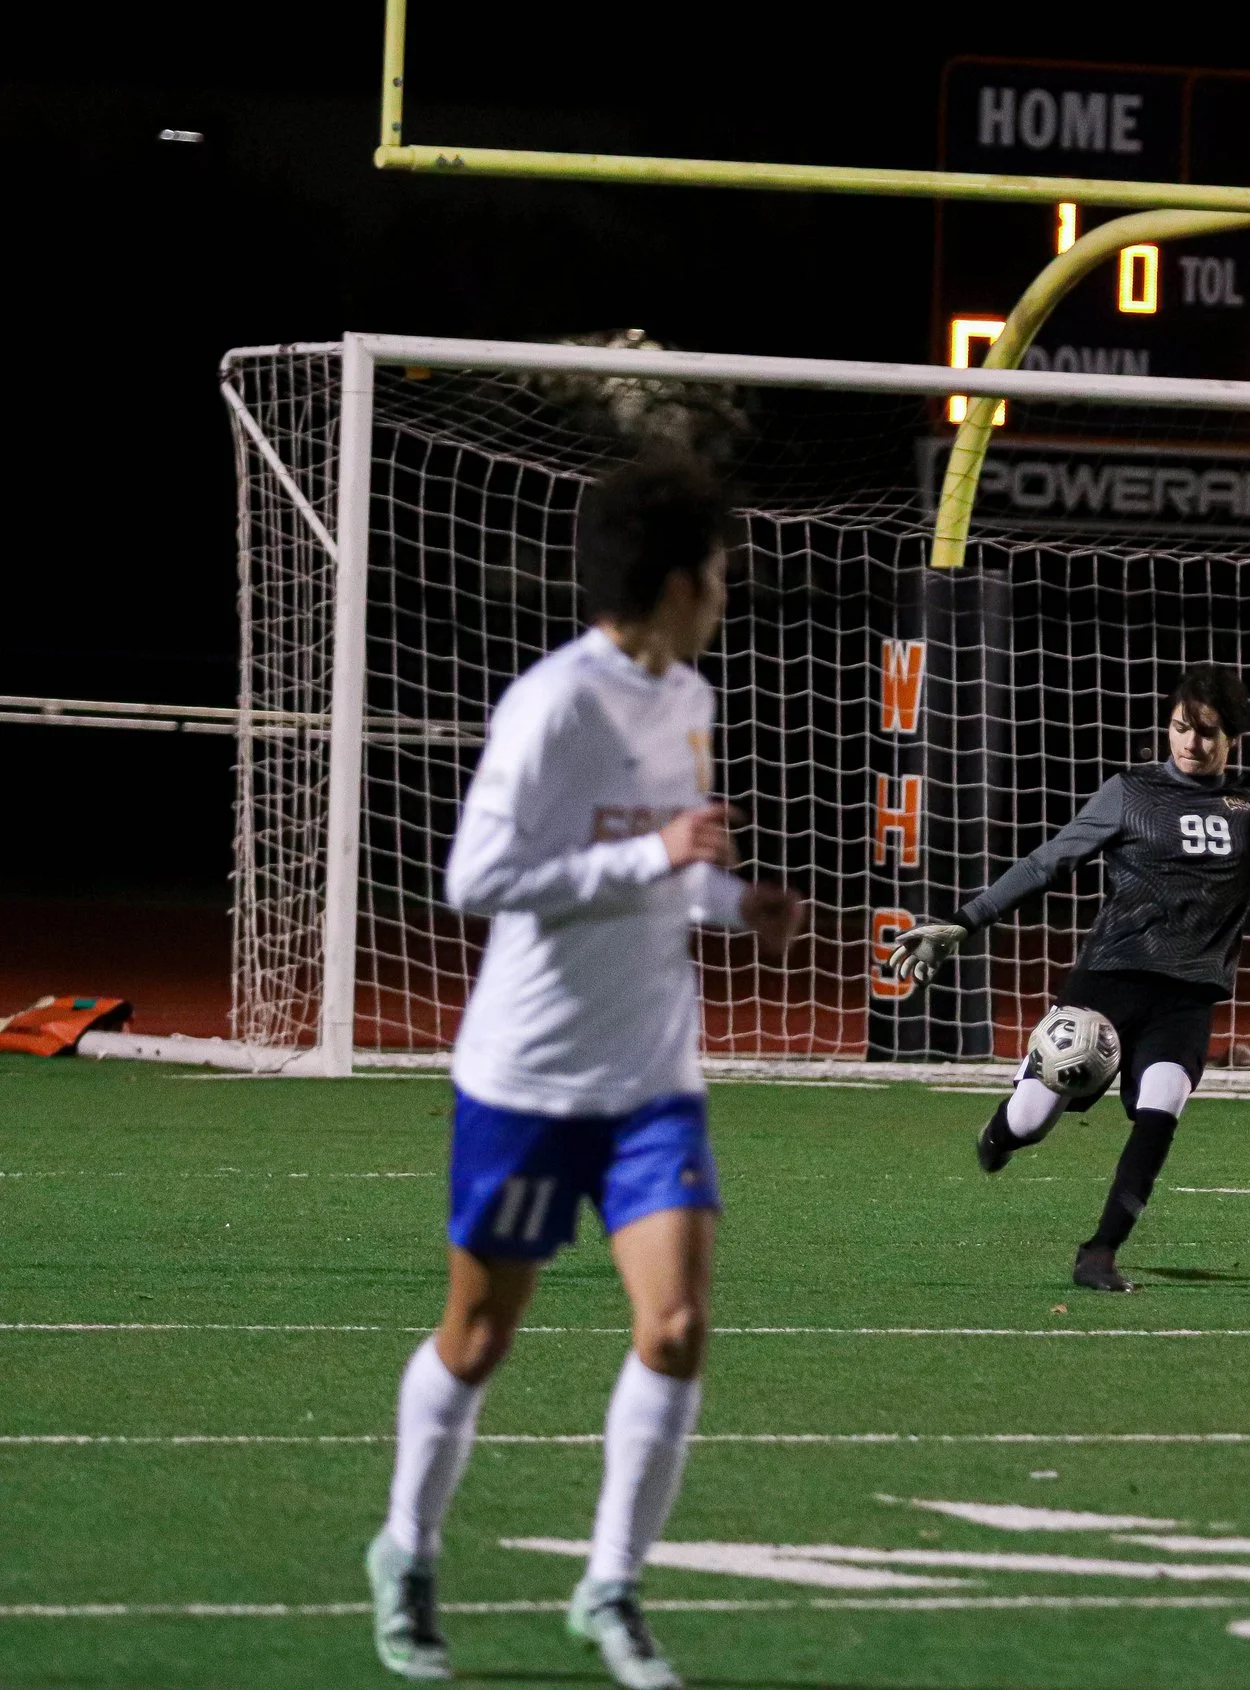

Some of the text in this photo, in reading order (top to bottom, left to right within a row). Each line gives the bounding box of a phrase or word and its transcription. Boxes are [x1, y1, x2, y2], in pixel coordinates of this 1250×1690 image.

[978, 86, 1144, 153] HOME
[1117, 243, 1160, 314] 0
[1180, 256, 1244, 307] TOL
[1179, 814, 1232, 856] 99
[493, 1175, 557, 1242] 11
